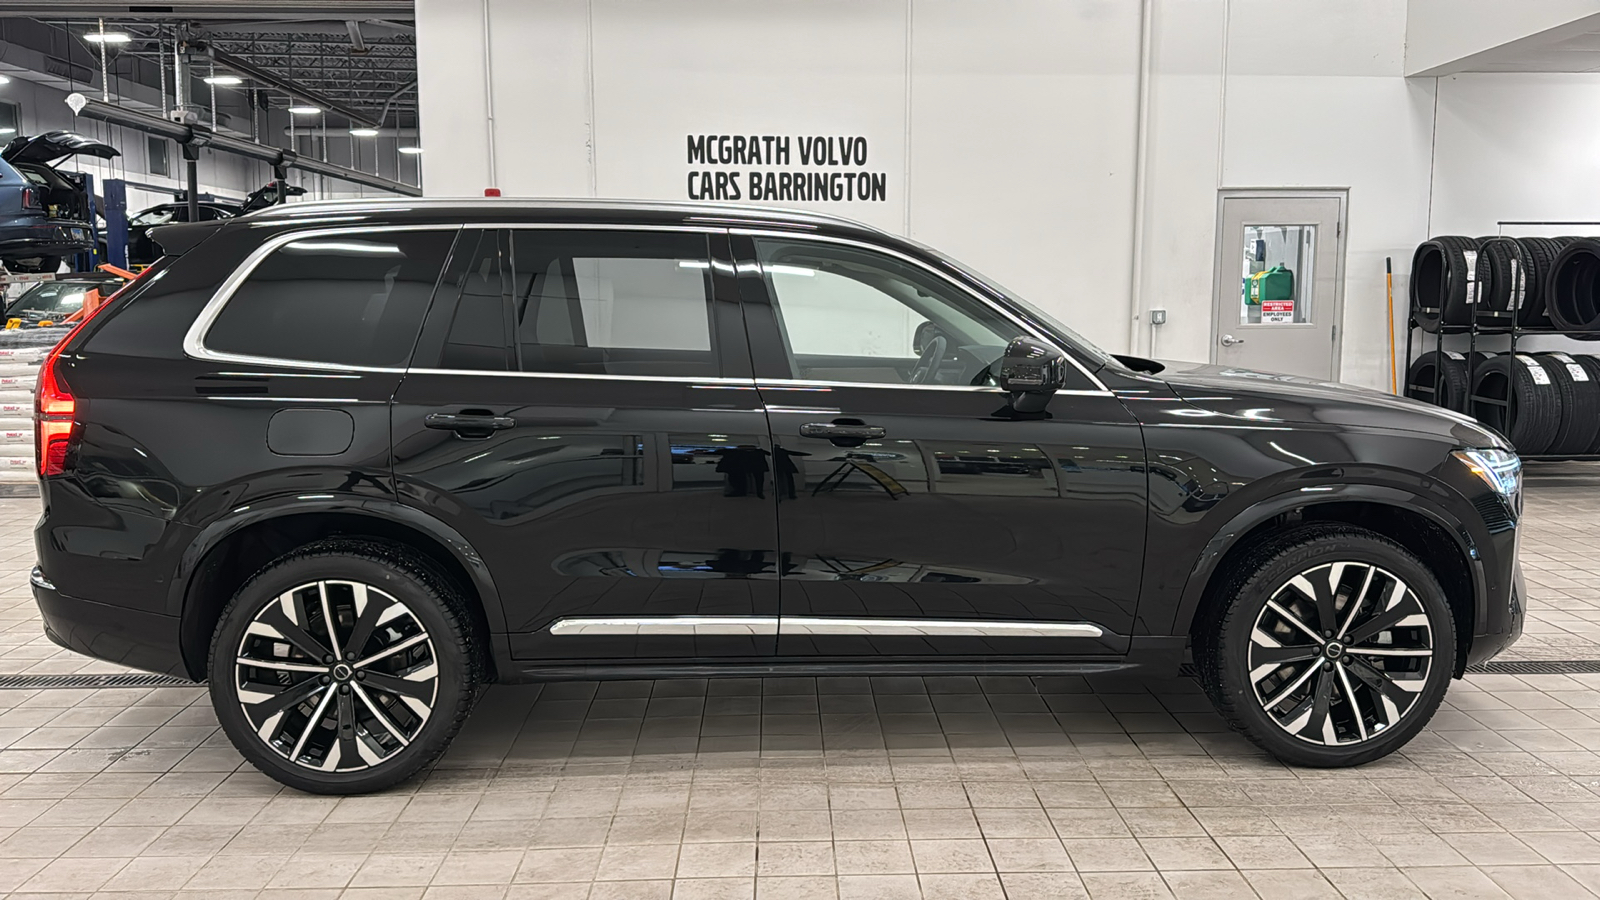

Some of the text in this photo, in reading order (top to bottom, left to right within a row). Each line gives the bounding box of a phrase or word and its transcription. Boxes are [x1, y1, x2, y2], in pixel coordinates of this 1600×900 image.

[687, 135, 868, 166] MCGRATH VOLVO
[687, 171, 887, 202] CARS BARRINGTON
